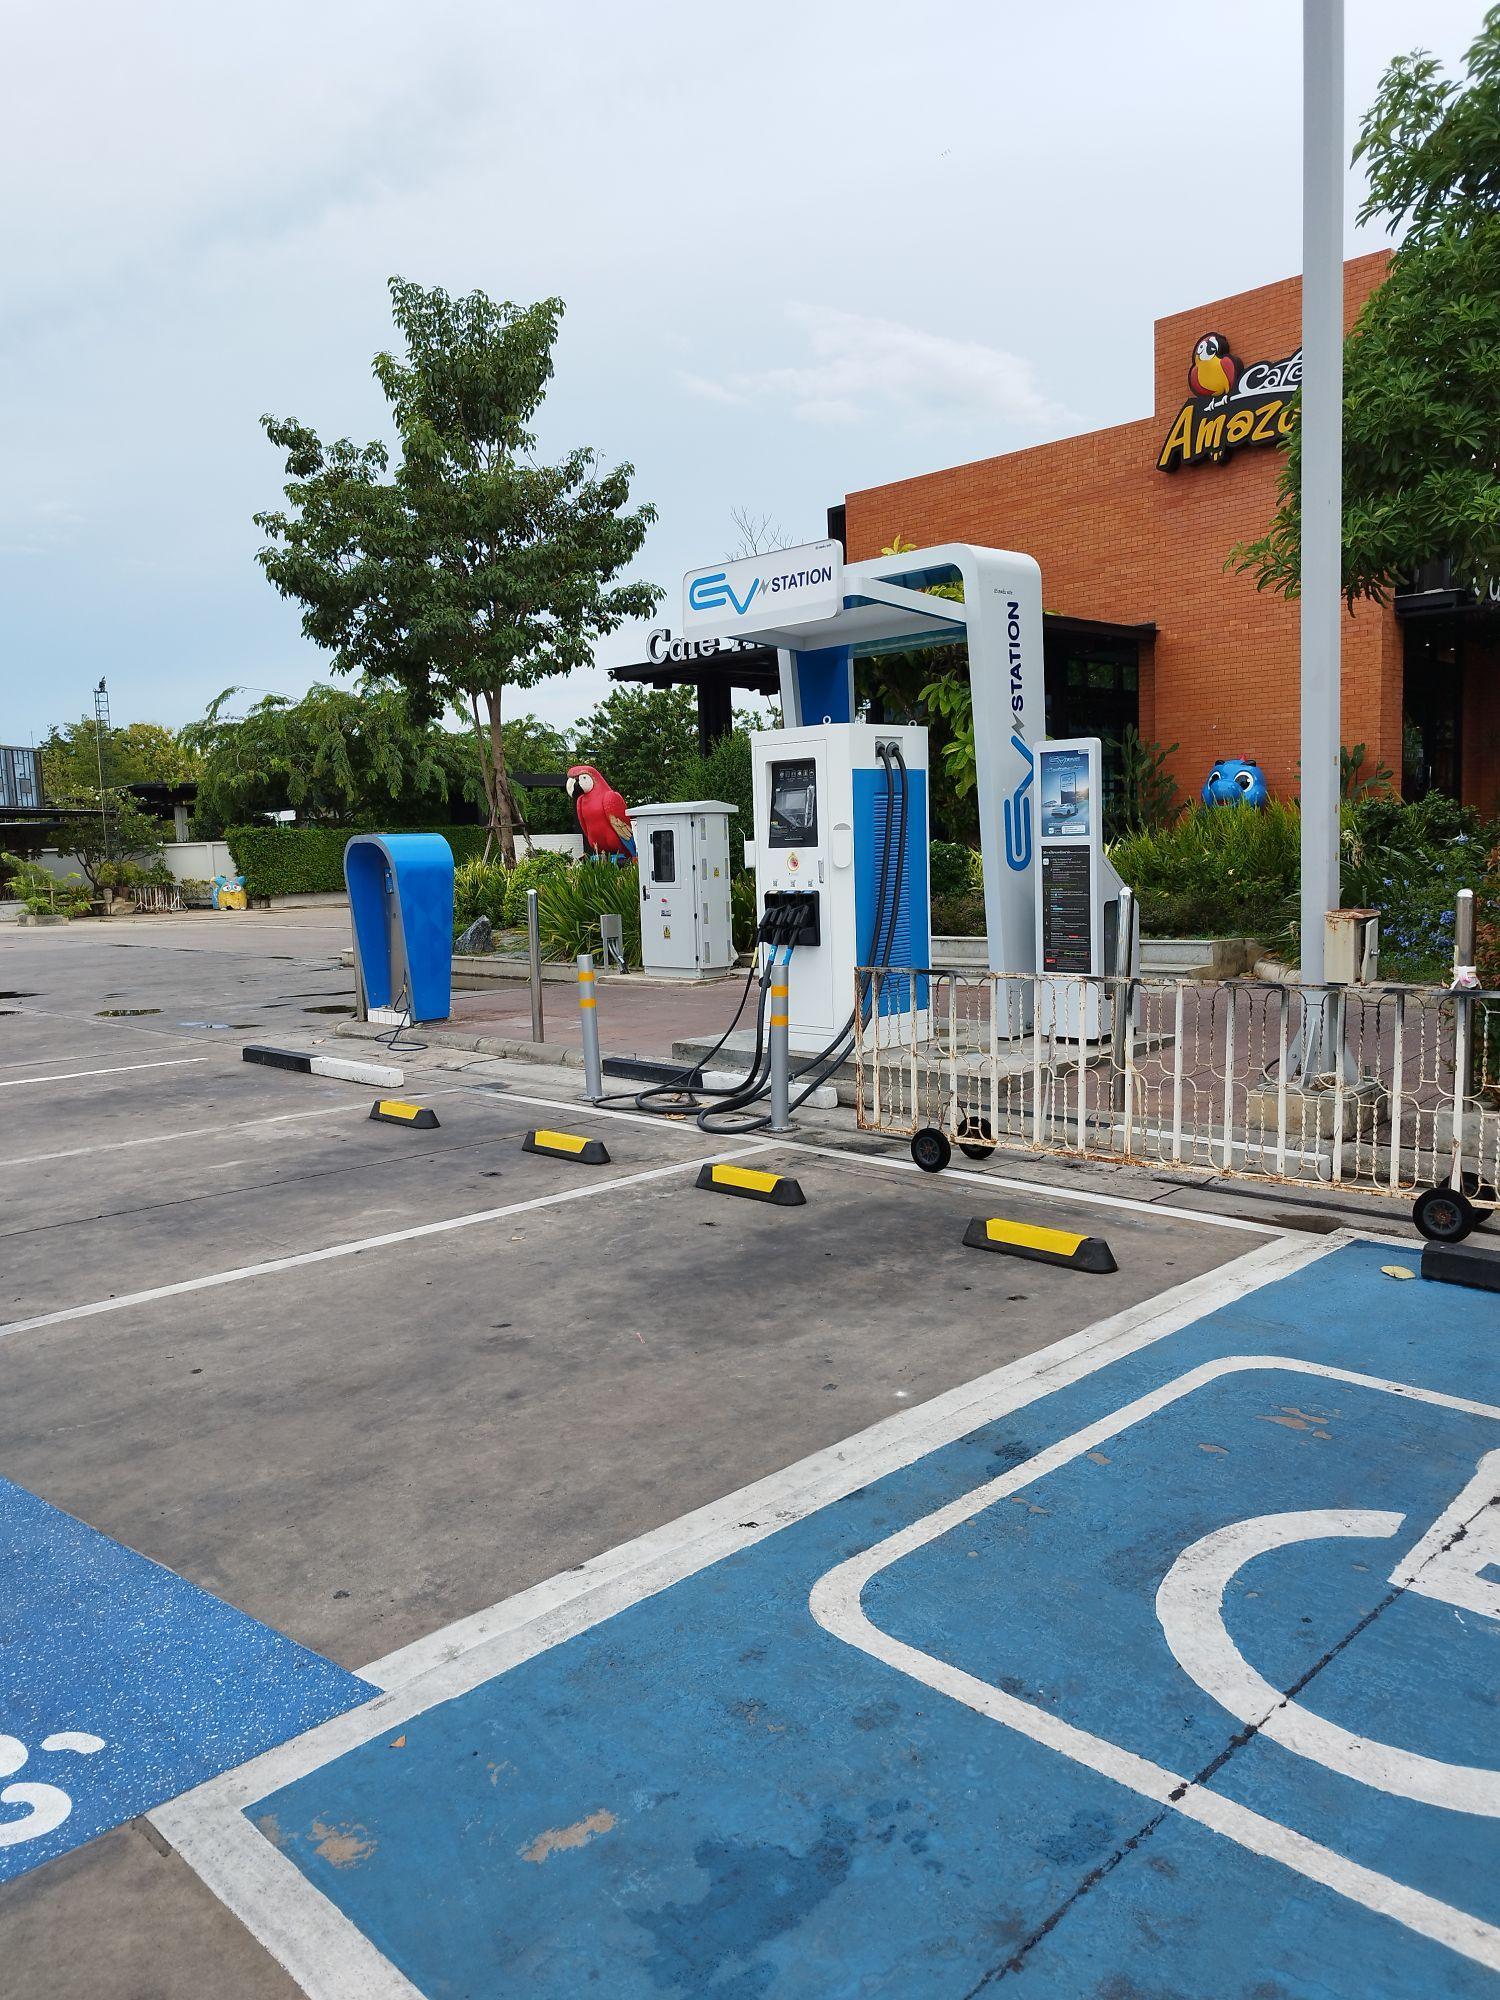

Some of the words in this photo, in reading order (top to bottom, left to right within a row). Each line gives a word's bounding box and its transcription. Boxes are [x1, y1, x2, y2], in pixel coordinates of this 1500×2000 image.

[689, 572, 760, 615] EV
[771, 566, 832, 593] STATION
[1006, 601, 1024, 712] STATION
